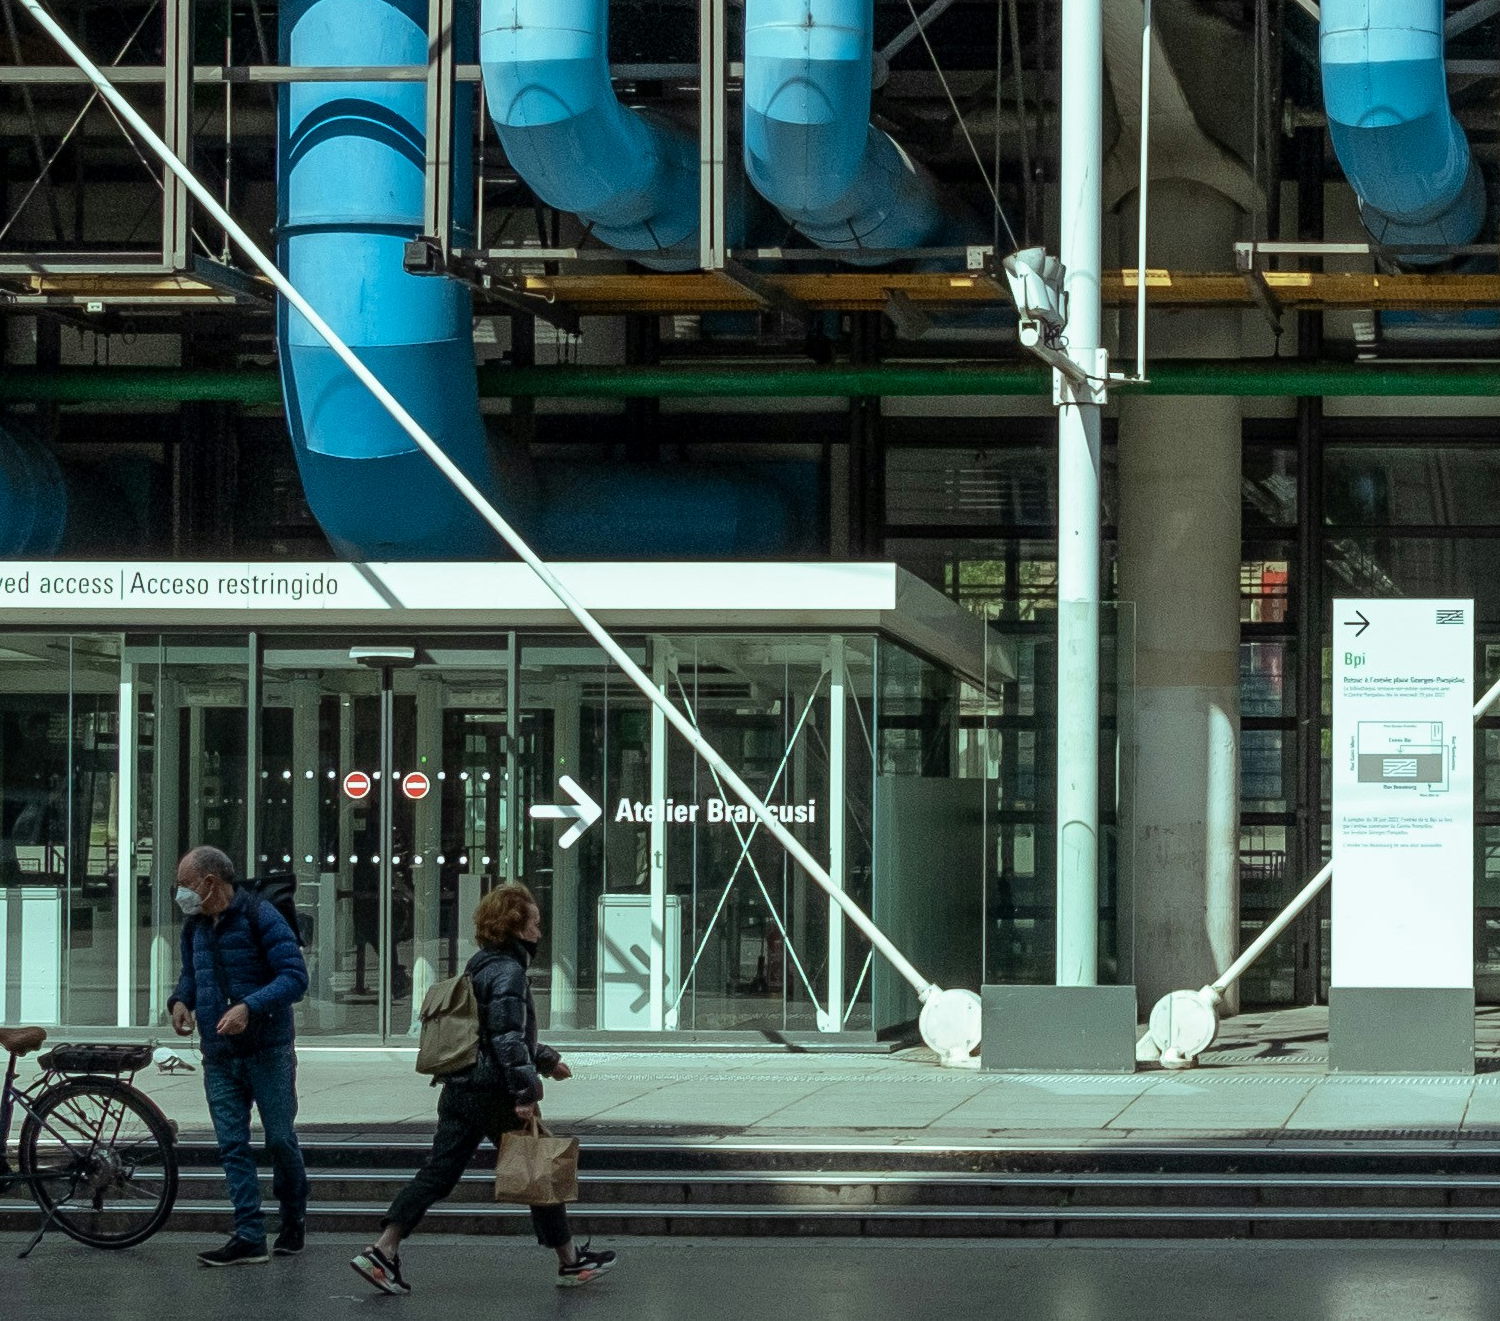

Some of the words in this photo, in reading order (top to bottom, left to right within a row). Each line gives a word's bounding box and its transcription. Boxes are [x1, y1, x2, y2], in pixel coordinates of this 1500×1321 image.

[39, 577, 114, 595] access
[130, 572, 209, 595] Acceso
[218, 572, 338, 601] restringido
[1344, 652, 1366, 669] Bpi
[613, 798, 700, 823] Atelier
